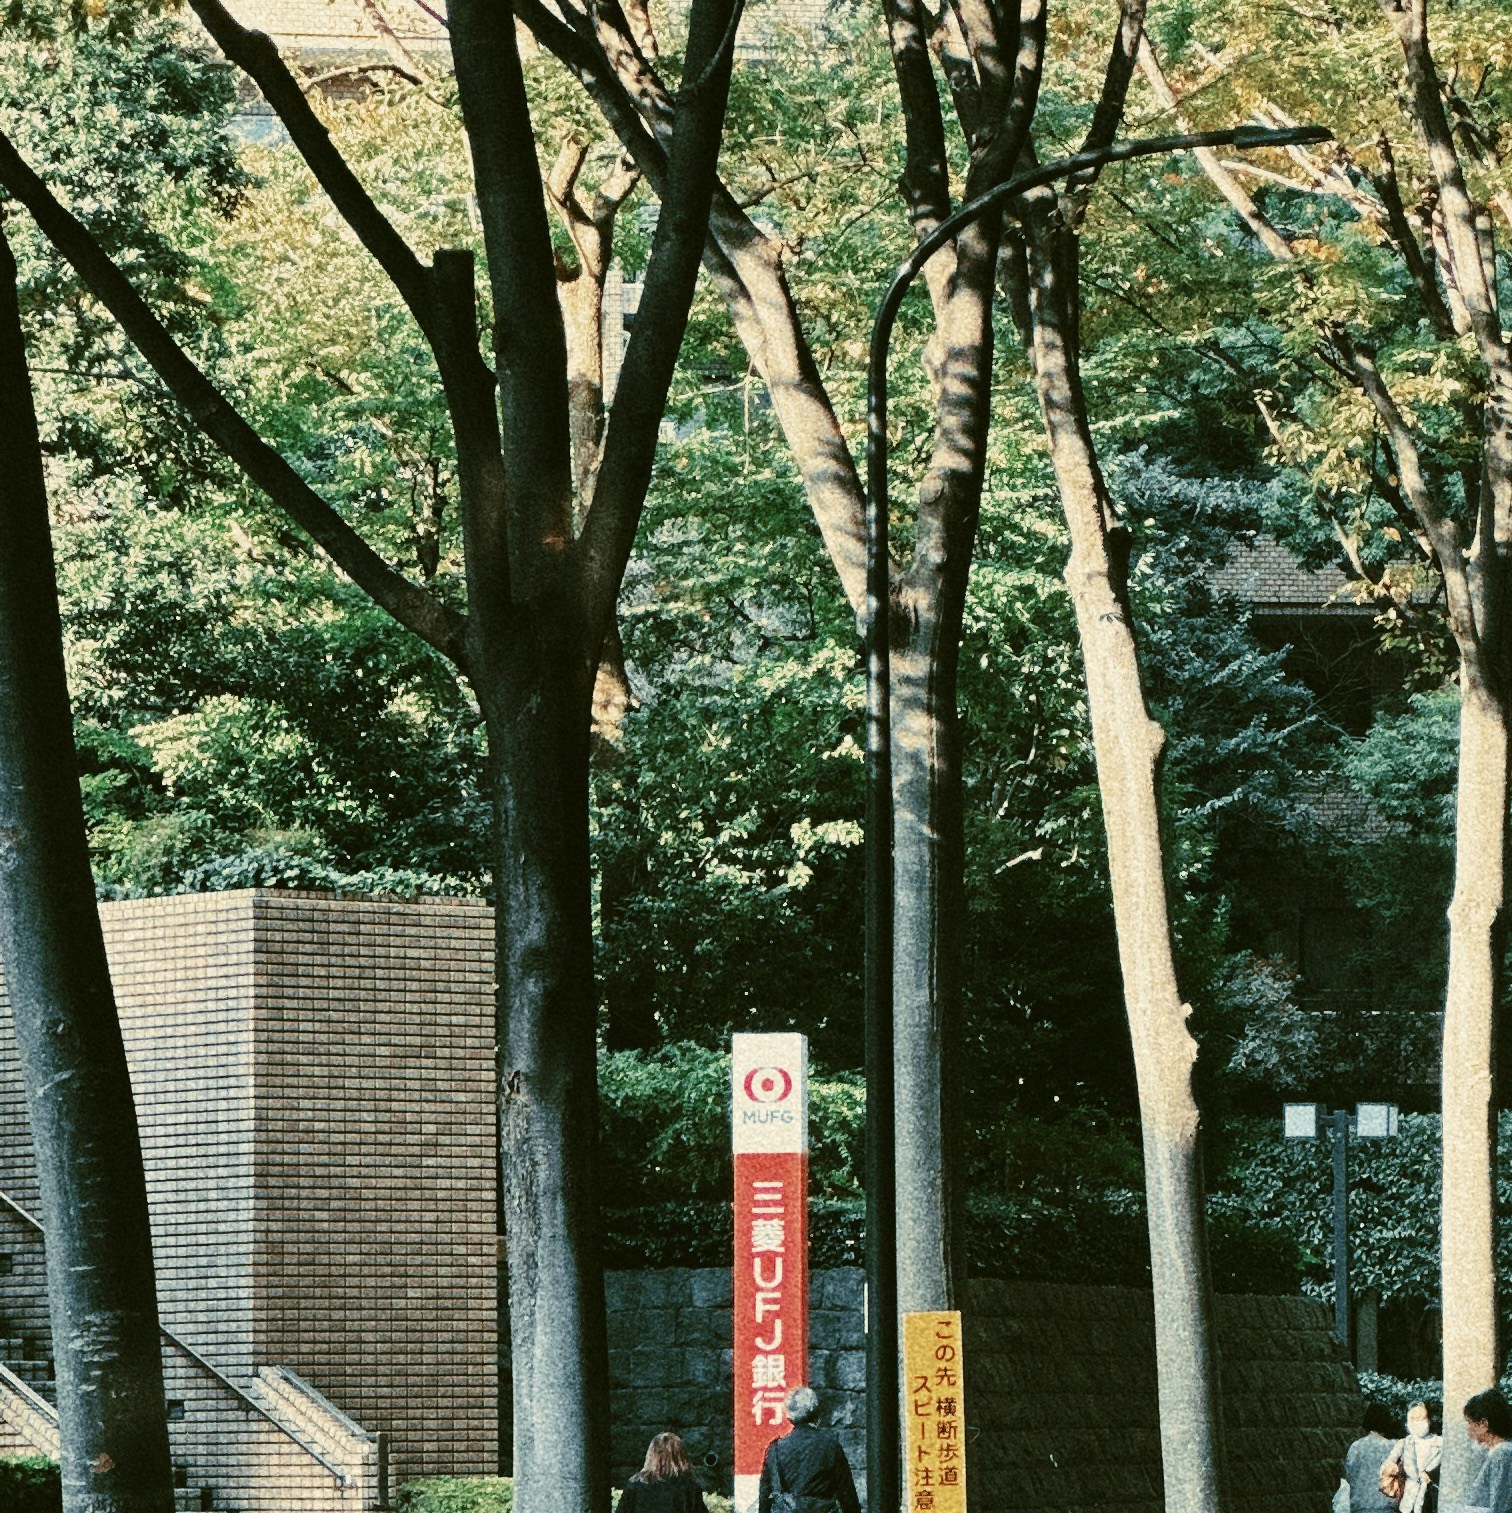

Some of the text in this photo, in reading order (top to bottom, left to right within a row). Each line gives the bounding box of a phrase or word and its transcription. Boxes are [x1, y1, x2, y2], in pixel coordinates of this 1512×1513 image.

[743, 1109, 794, 1125] MUFG
[750, 1180, 786, 1426] 三菱UFJ銀行
